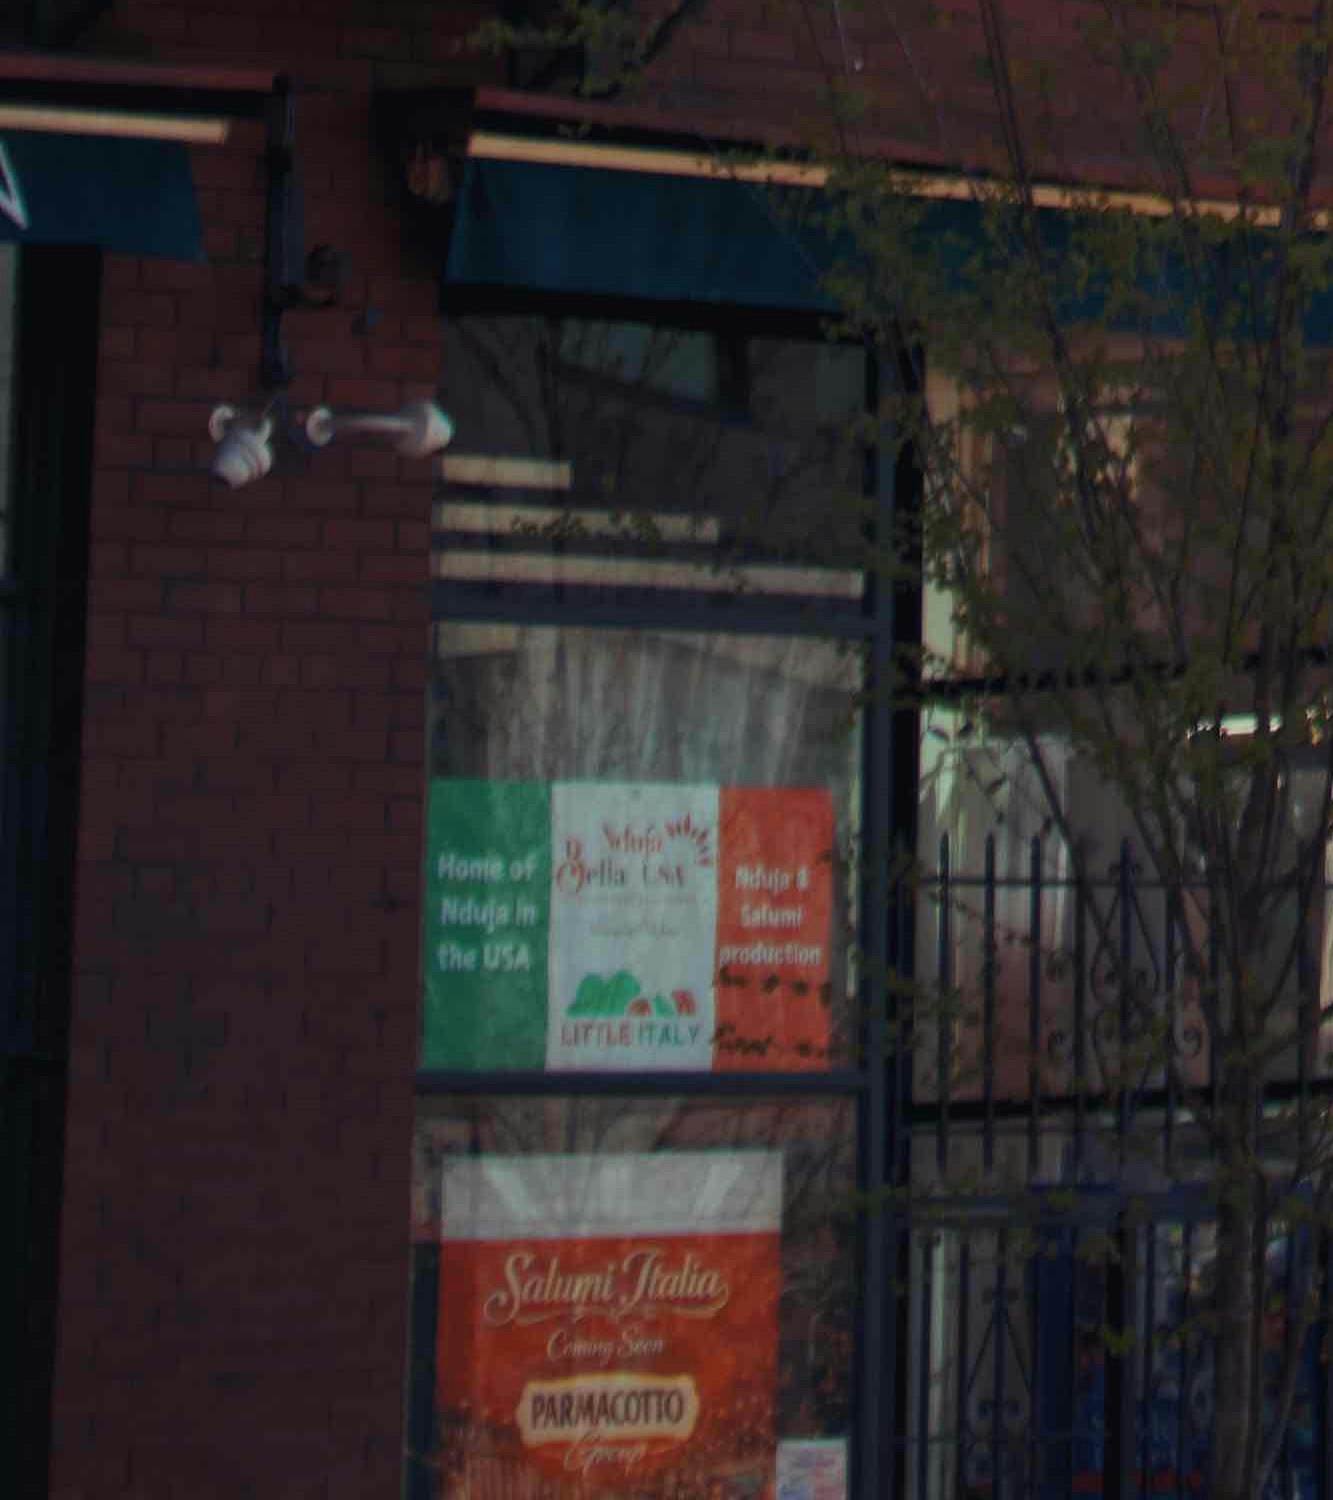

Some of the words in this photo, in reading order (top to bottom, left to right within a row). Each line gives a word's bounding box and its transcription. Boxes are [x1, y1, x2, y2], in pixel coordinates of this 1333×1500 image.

[437, 854, 504, 880] Home
[508, 853, 537, 881] of
[440, 897, 509, 934] Nduja
[515, 895, 537, 924] in
[740, 904, 803, 928] Salumi
[437, 943, 477, 971] the
[482, 943, 531, 972] USA
[719, 942, 822, 967] production
[560, 1022, 633, 1047] LITTLE
[637, 1022, 704, 1047] ITALY
[484, 1250, 615, 1324] Salumi
[620, 1247, 729, 1320] Italia
[547, 1330, 616, 1366] Coming
[617, 1327, 665, 1359] Soon
[530, 1388, 685, 1428] PARMACOTTO
[563, 1428, 648, 1477] Group
